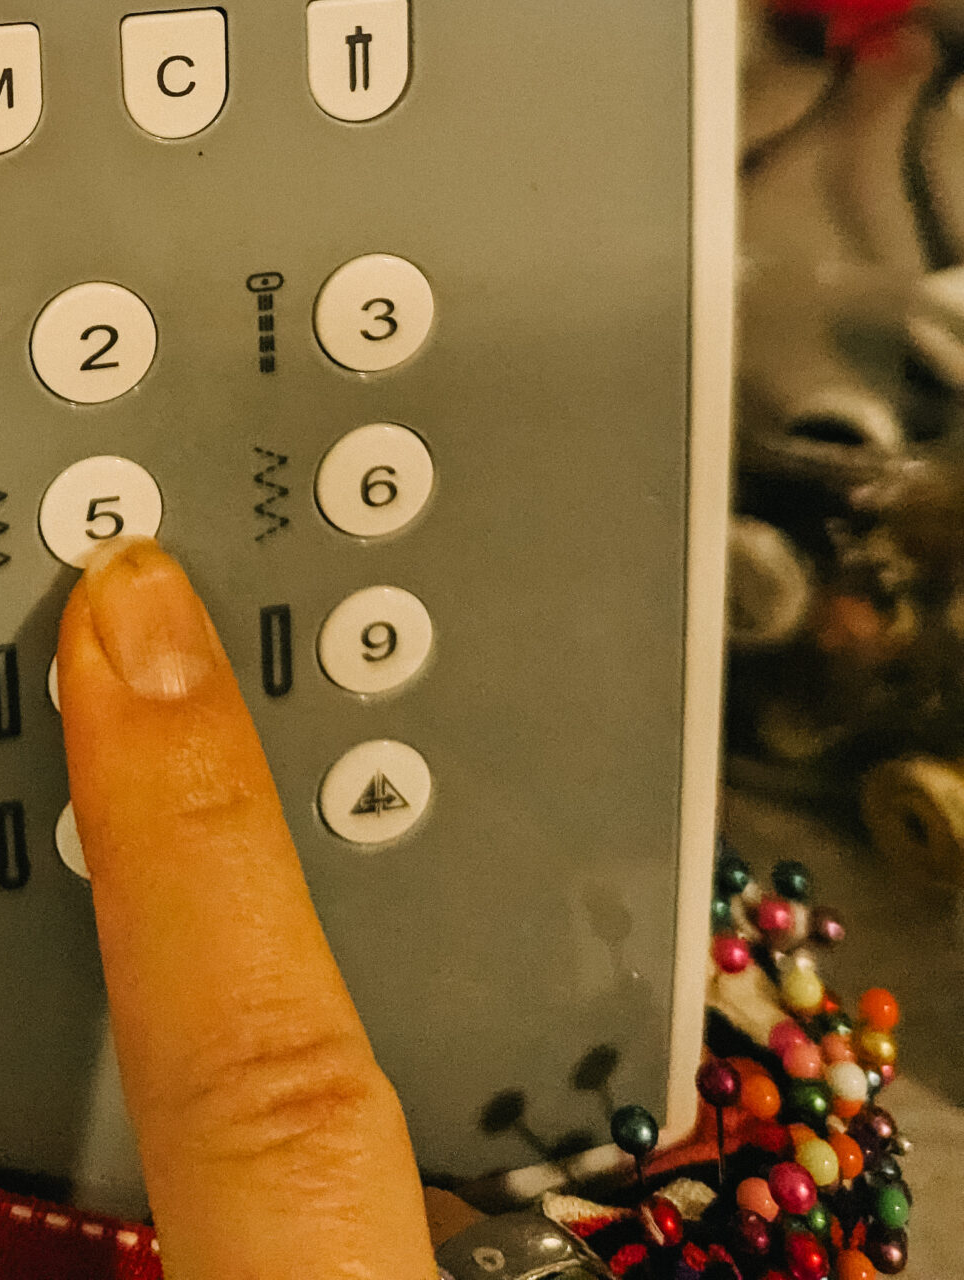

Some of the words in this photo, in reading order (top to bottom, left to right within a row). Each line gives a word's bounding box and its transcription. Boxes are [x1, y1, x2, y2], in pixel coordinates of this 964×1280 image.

[156, 54, 196, 98] C
[360, 297, 399, 342] 3
[79, 324, 120, 372] 2
[360, 465, 399, 509] 6
[85, 495, 125, 541] 5
[360, 621, 398, 664] 9
